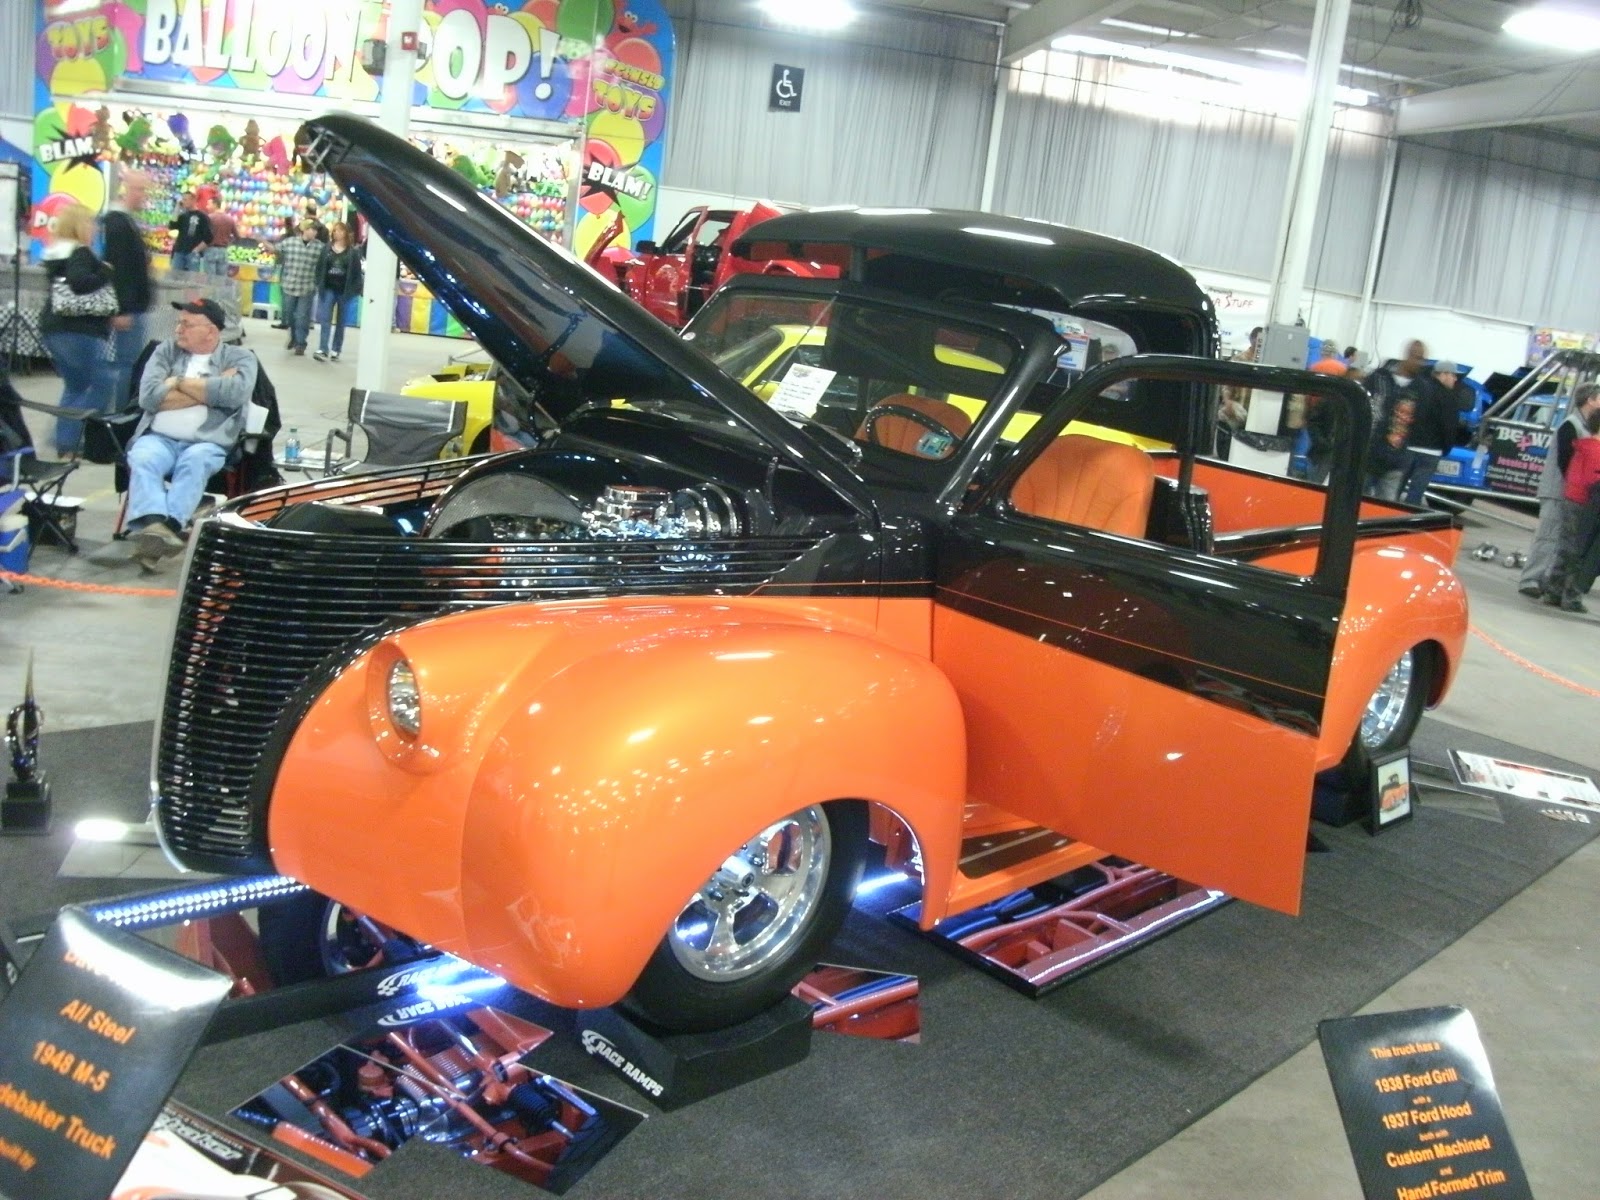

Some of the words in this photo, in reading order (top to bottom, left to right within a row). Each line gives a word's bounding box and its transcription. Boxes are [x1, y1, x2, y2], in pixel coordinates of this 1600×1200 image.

[47, 15, 109, 59] TOYS
[143, 0, 363, 82] BALLOON
[593, 79, 656, 120] TOYS
[587, 161, 652, 200] BLAM!
[60, 999, 92, 1023] All
[87, 1010, 136, 1044] Steel
[33, 1040, 75, 1075] 1948
[72, 1060, 110, 1092] M-5
[596, 1041, 626, 1068] RACE
[622, 1062, 664, 1097] RAMPS
[1371, 1047, 1393, 1059] This
[1391, 1043, 1417, 1057] truck
[1415, 1042, 1434, 1053] has
[1375, 1075, 1404, 1093] 1938
[1402, 1071, 1433, 1089] Ford
[1431, 1067, 1458, 1084] Grill
[1381, 1111, 1410, 1129] 1937
[1409, 1106, 1440, 1125] Ford
[1438, 1101, 1473, 1120] Hood
[65, 1114, 117, 1159] Truck
[1385, 1148, 1434, 1168] Custom
[1432, 1134, 1491, 1158] Machined
[1396, 1182, 1432, 1200] Hand
[1430, 1172, 1478, 1197] Formed
[1476, 1169, 1506, 1187] Trim
